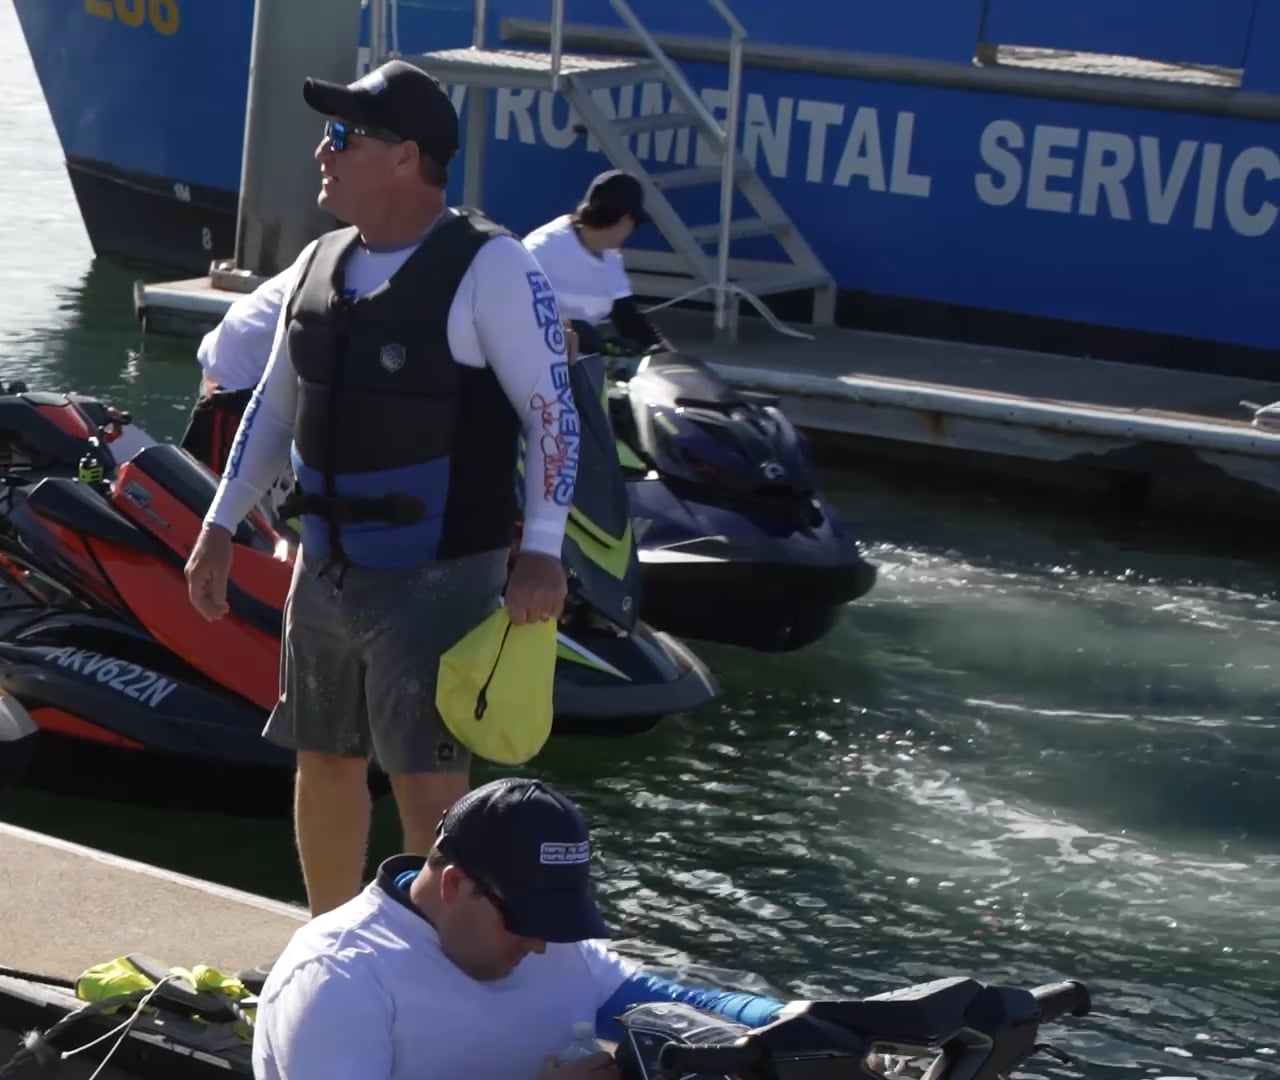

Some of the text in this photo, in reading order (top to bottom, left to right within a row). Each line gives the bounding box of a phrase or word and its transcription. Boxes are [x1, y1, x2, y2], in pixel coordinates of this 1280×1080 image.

[356, 47, 1280, 237] RONMENTAL SERVIC
[526, 272, 567, 355] H2O
[44, 647, 178, 708] AKV622N
